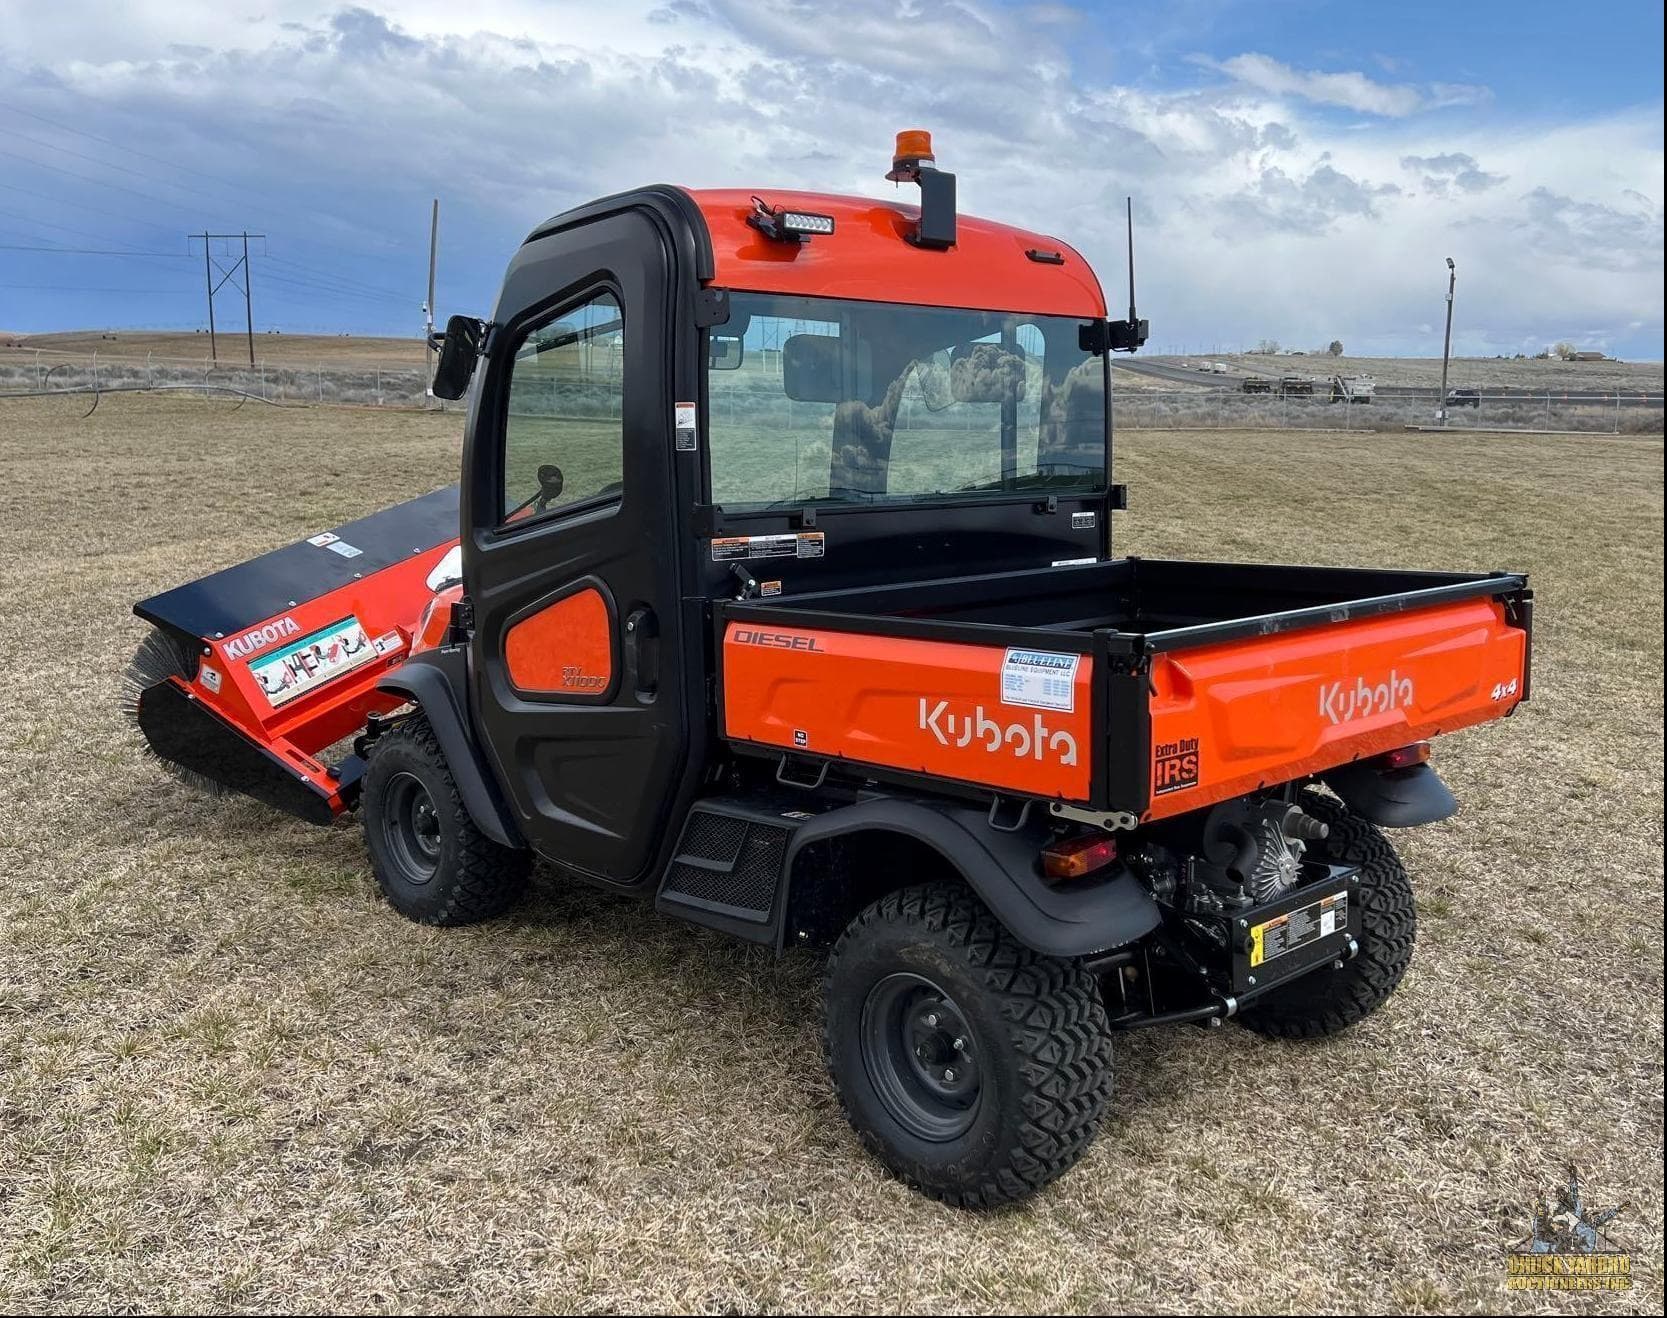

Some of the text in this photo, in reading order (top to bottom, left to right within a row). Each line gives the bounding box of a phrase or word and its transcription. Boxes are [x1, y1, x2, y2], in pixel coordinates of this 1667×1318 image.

[222, 616, 301, 660] KUBOTA
[734, 630, 824, 652] DIESEL
[1030, 667, 1059, 676] EQUIPMENT
[1319, 669, 1413, 725] Kubota
[1490, 678, 1518, 701] 4x4
[919, 698, 1077, 767] Kubota
[1155, 737, 1199, 758] Extra Duty
[1156, 755, 1197, 786] IRS
